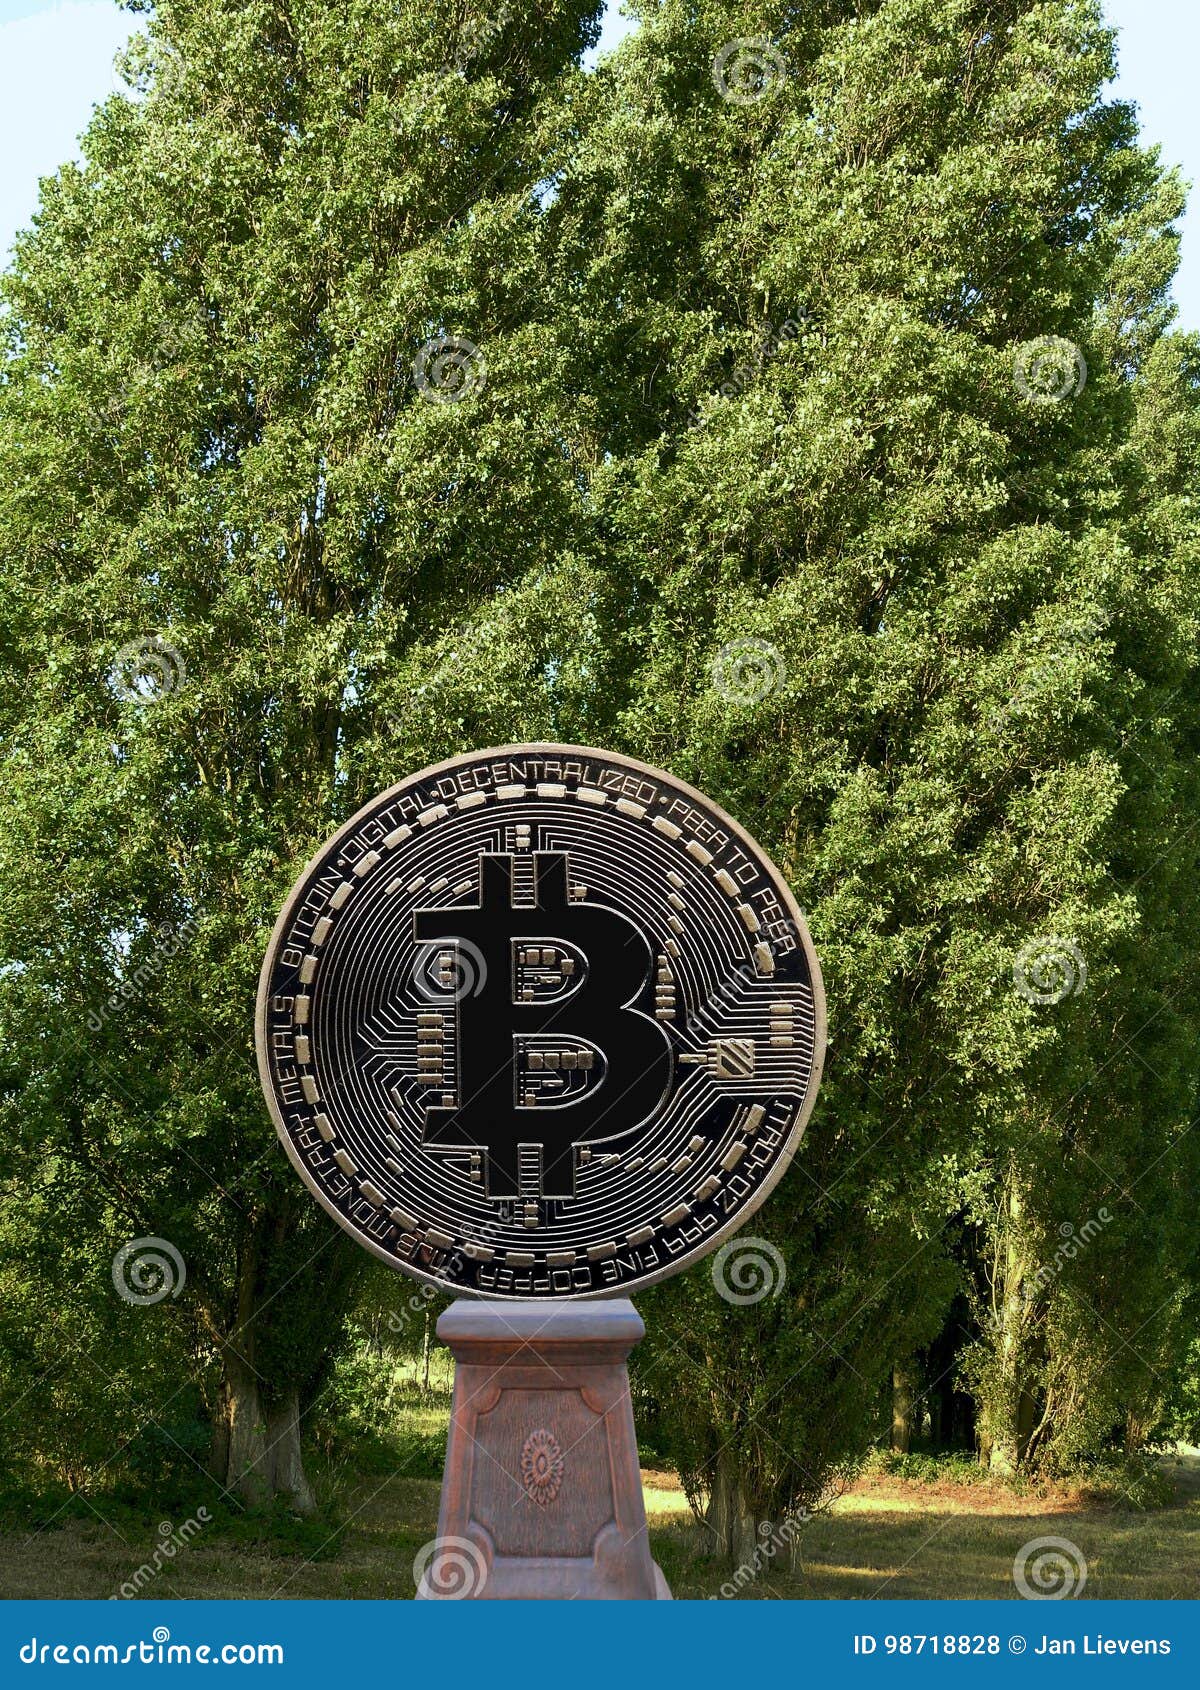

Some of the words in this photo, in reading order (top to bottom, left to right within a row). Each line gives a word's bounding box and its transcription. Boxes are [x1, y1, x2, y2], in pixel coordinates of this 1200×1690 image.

[280, 865, 343, 967] BITCOIN
[340, 788, 434, 863] DIGITAL
[436, 760, 657, 803] DECENTRALIZED
[668, 798, 729, 851] PEER
[722, 846, 760, 884] TO
[753, 887, 798, 957] PEER
[271, 996, 306, 1105] METALS
[288, 1112, 393, 1240] MONETARY
[601, 1245, 660, 1282] FINE
[662, 1210, 717, 1254] 999
[477, 1264, 592, 1290] COPPER
